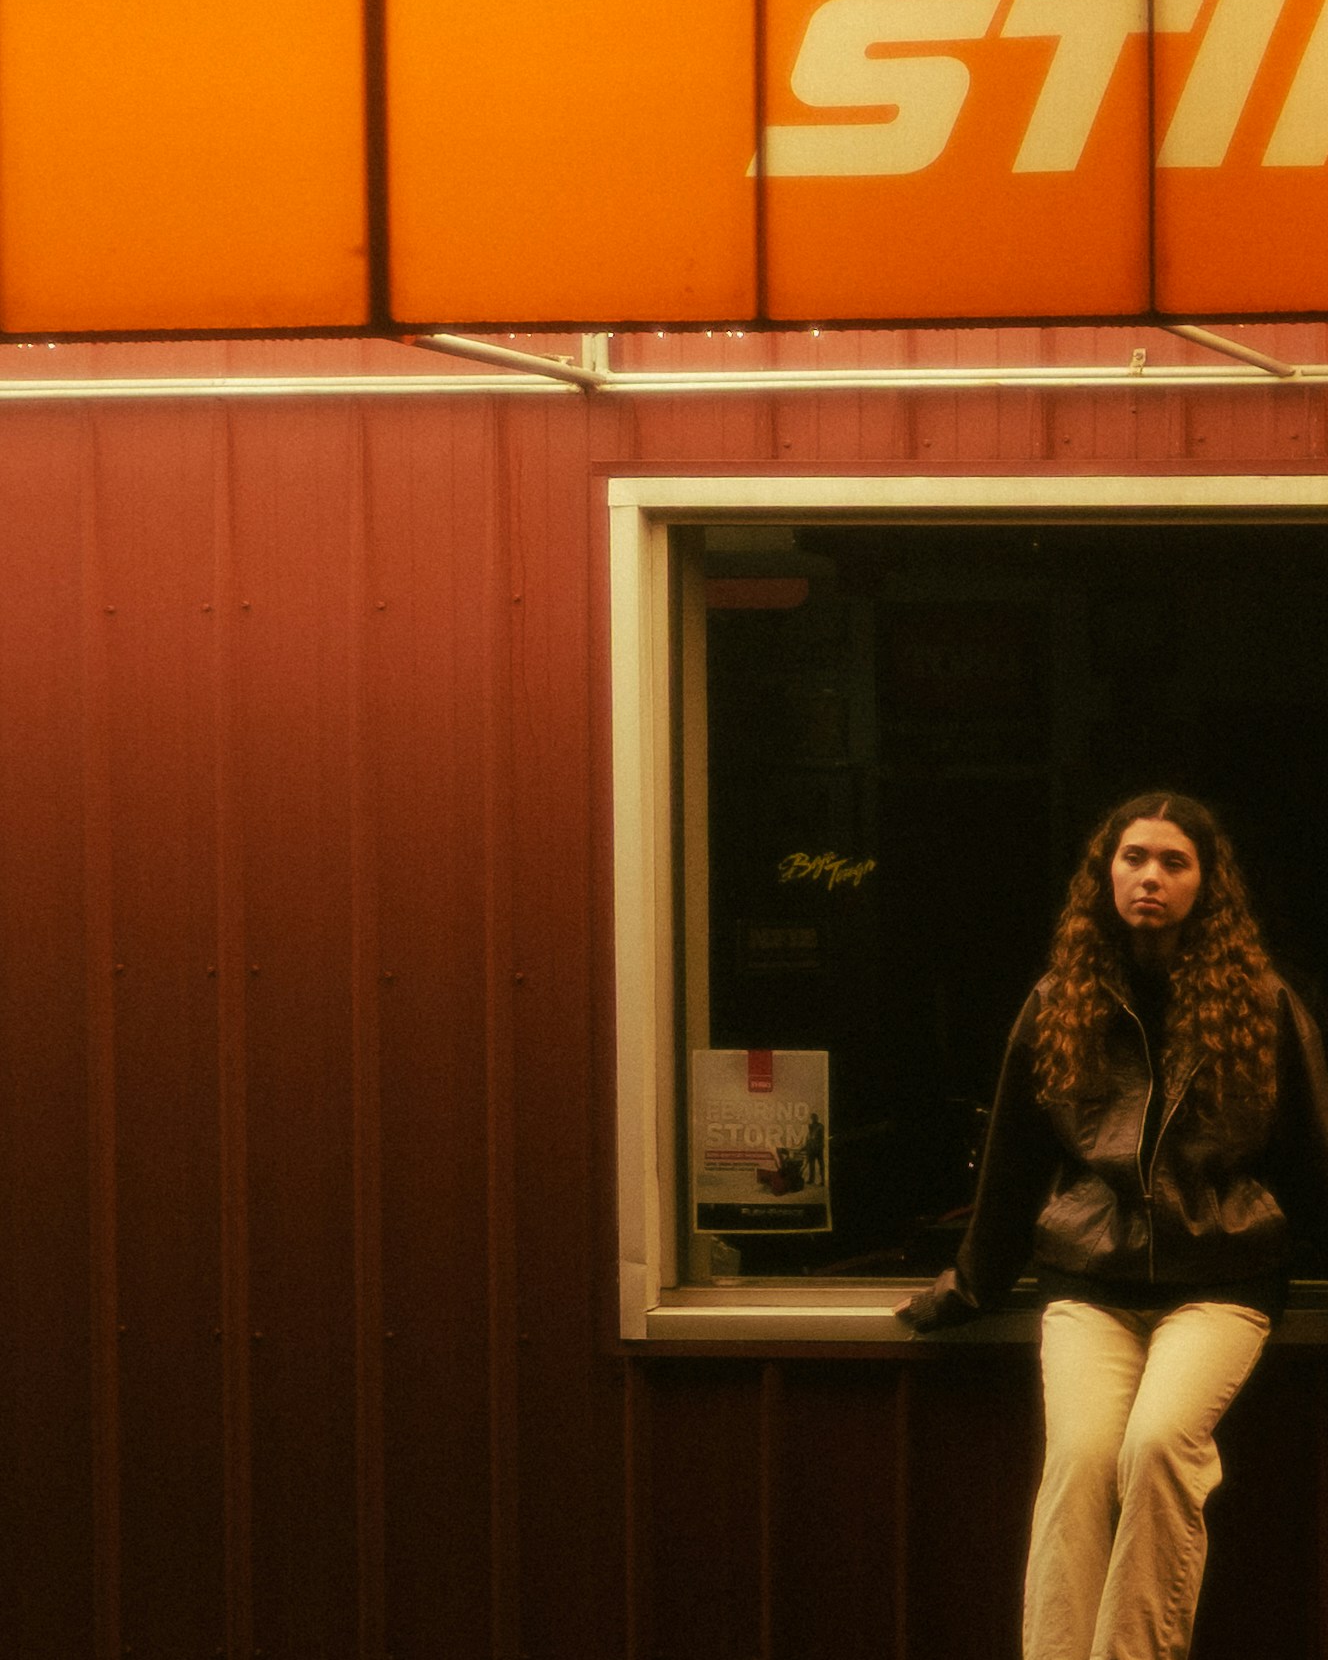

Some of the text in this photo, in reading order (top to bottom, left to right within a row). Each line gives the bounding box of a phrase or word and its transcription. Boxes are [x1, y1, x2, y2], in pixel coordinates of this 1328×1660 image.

[706, 1100, 809, 1121] FEAR NO
[706, 1123, 809, 1148] STORM
